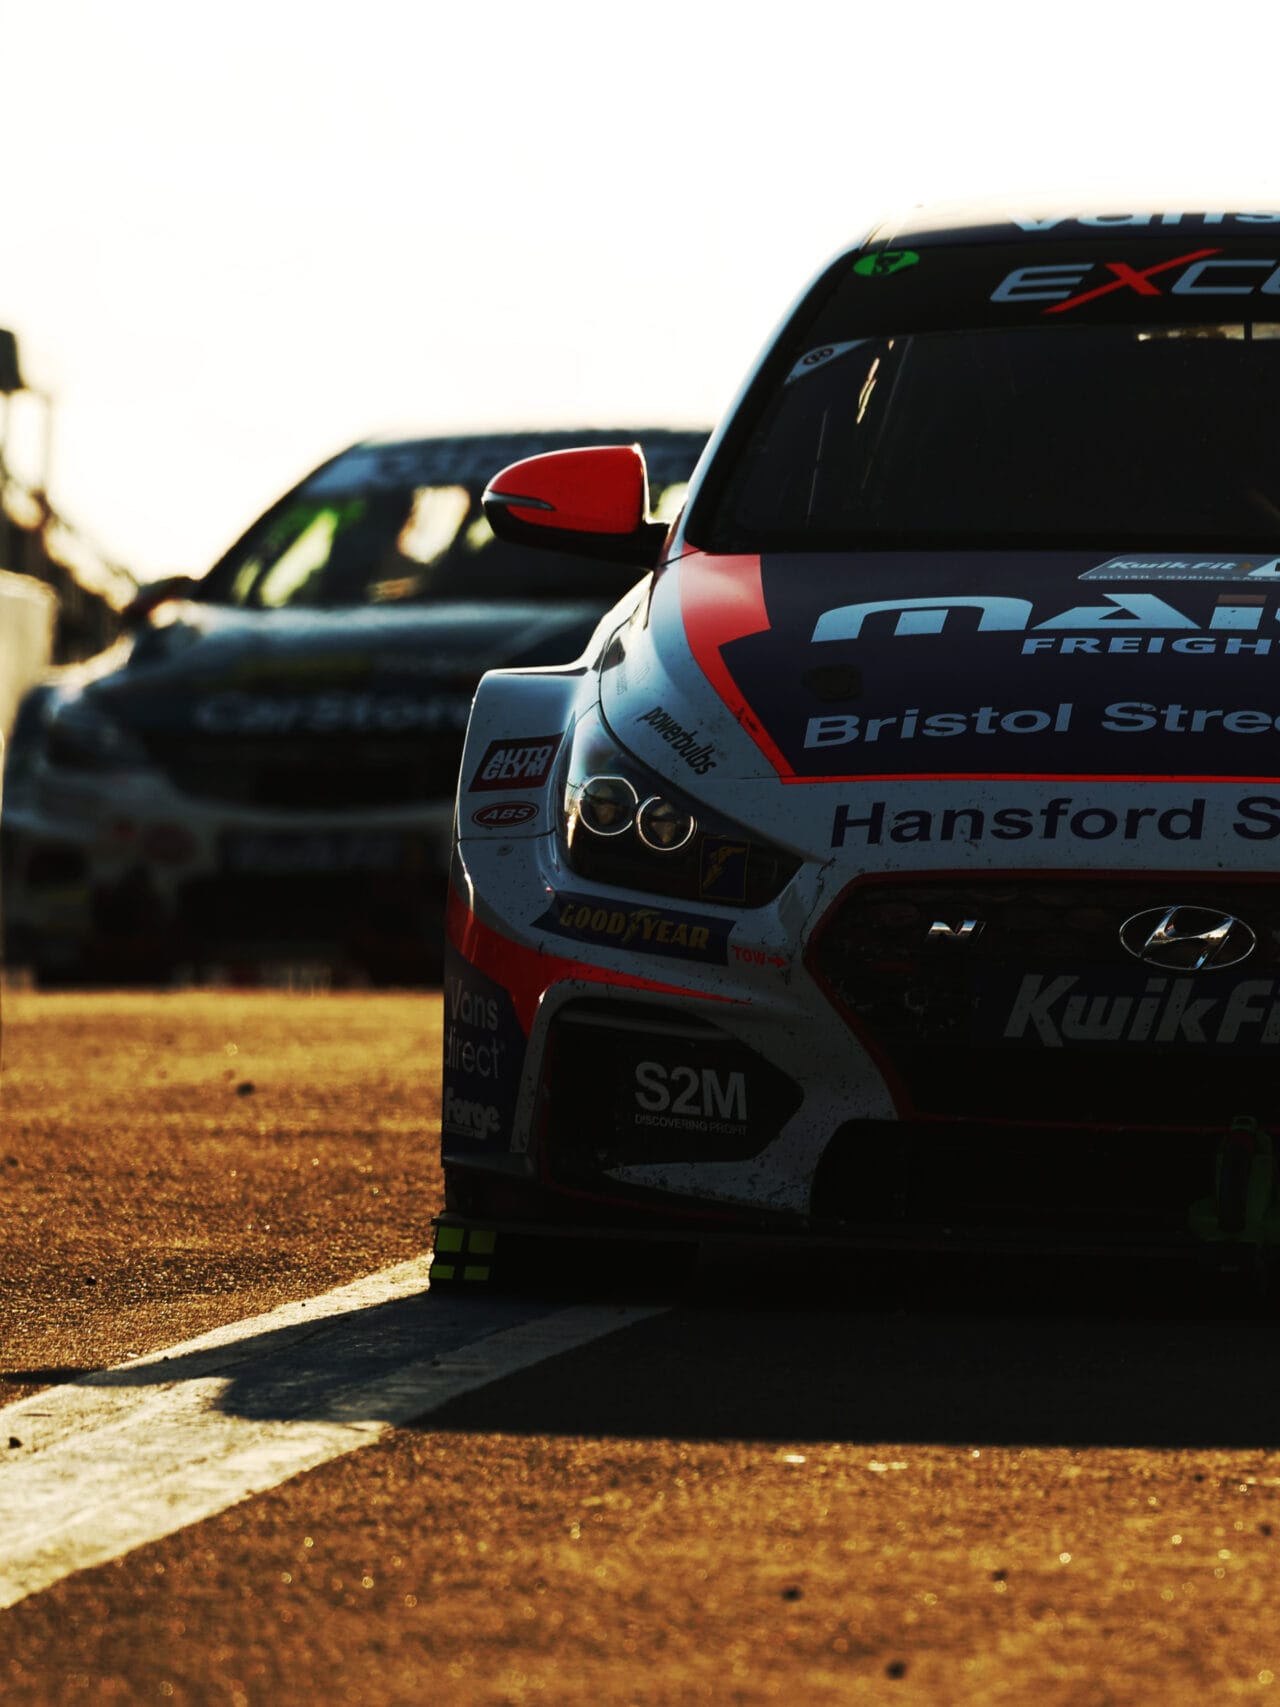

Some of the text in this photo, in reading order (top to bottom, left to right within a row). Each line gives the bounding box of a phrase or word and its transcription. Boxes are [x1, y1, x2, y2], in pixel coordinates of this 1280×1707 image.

[636, 706, 717, 774] powerbulbs
[803, 703, 1073, 749] Bristol
[483, 808, 530, 820] ABS
[831, 798, 1206, 848] Hansford
[733, 944, 766, 965] TOW
[634, 1061, 748, 1120] S2M
